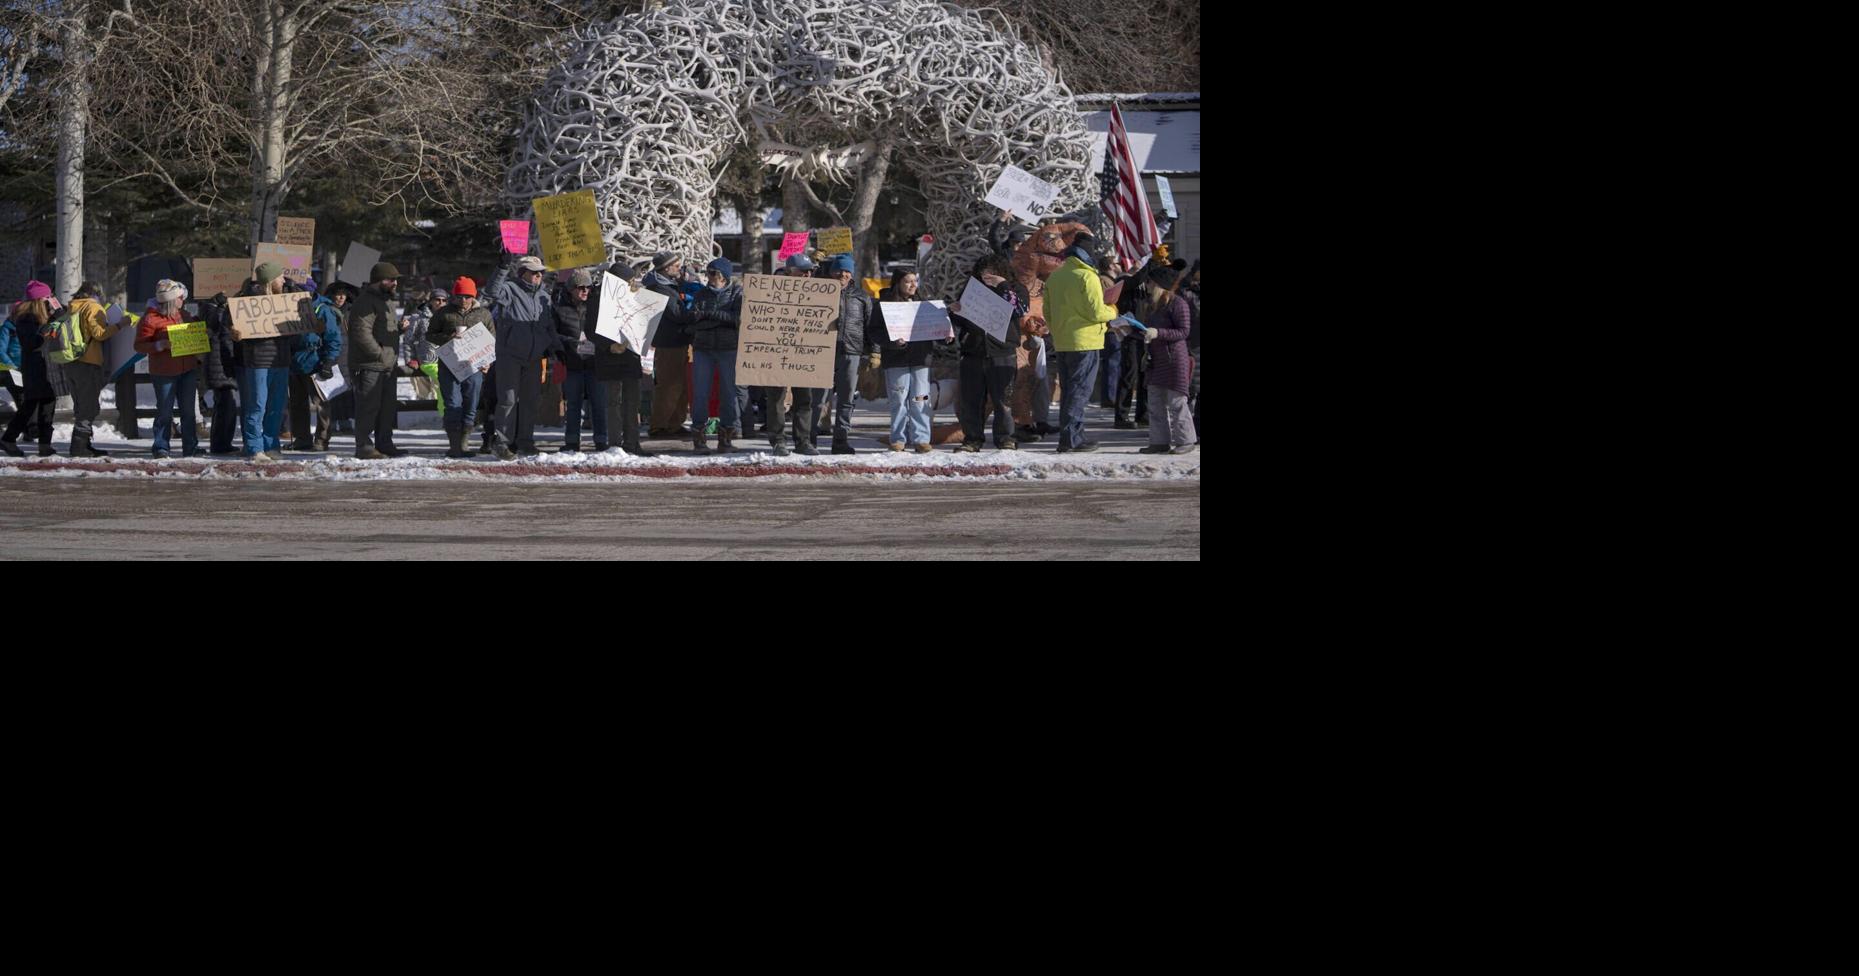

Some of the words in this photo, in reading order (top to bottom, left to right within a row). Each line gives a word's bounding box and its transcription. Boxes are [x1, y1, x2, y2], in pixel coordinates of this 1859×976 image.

[1027, 201, 1045, 216] NO
[749, 304, 775, 315] WHO
[796, 307, 834, 319] NEXT?
[776, 316, 798, 325] THINK
[803, 319, 824, 328] THIS
[779, 325, 801, 333] NEVER
[776, 337, 804, 347] YOU!
[744, 344, 789, 354] IMPEACH
[794, 347, 823, 355] TRUMP
[742, 361, 756, 369] ALL
[760, 361, 773, 369] HIS
[780, 362, 816, 372] THUGS
